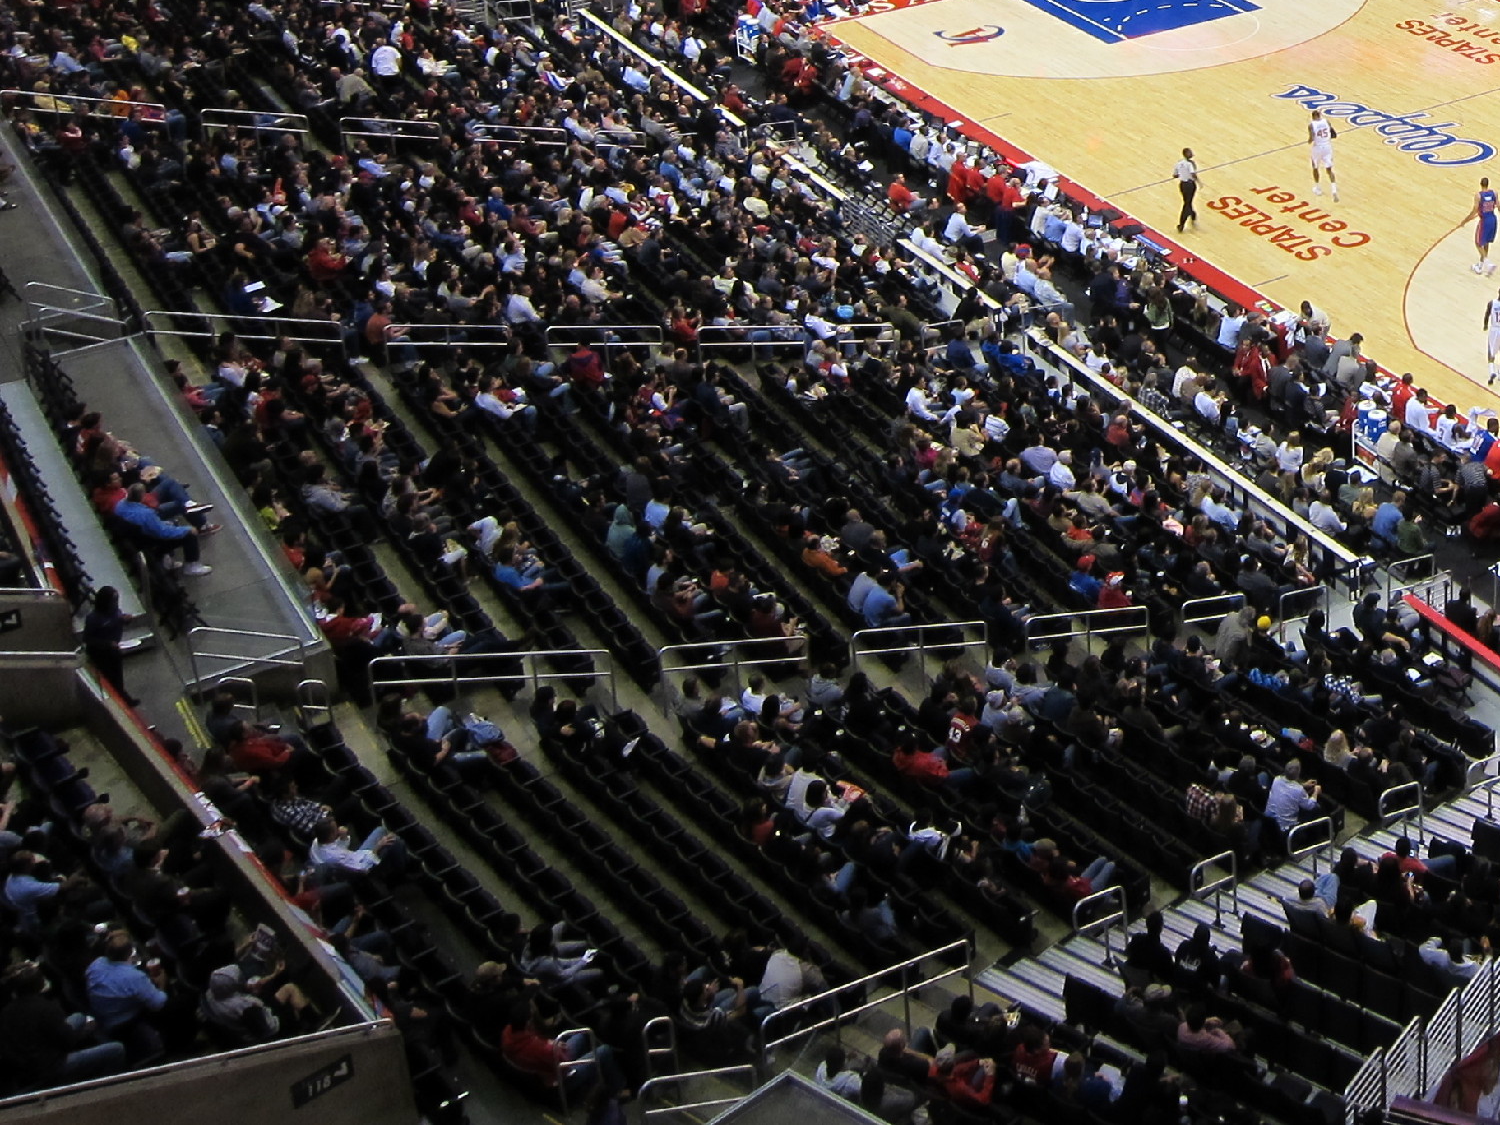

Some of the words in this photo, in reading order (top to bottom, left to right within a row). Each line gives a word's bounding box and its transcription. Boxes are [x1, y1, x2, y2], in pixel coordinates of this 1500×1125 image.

[1270, 83, 1499, 168] Clippers
[1317, 129, 1328, 139] 45
[1206, 195, 1332, 262] STAPLES
[1249, 185, 1372, 249] Center
[308, 1074, 332, 1097] 118
